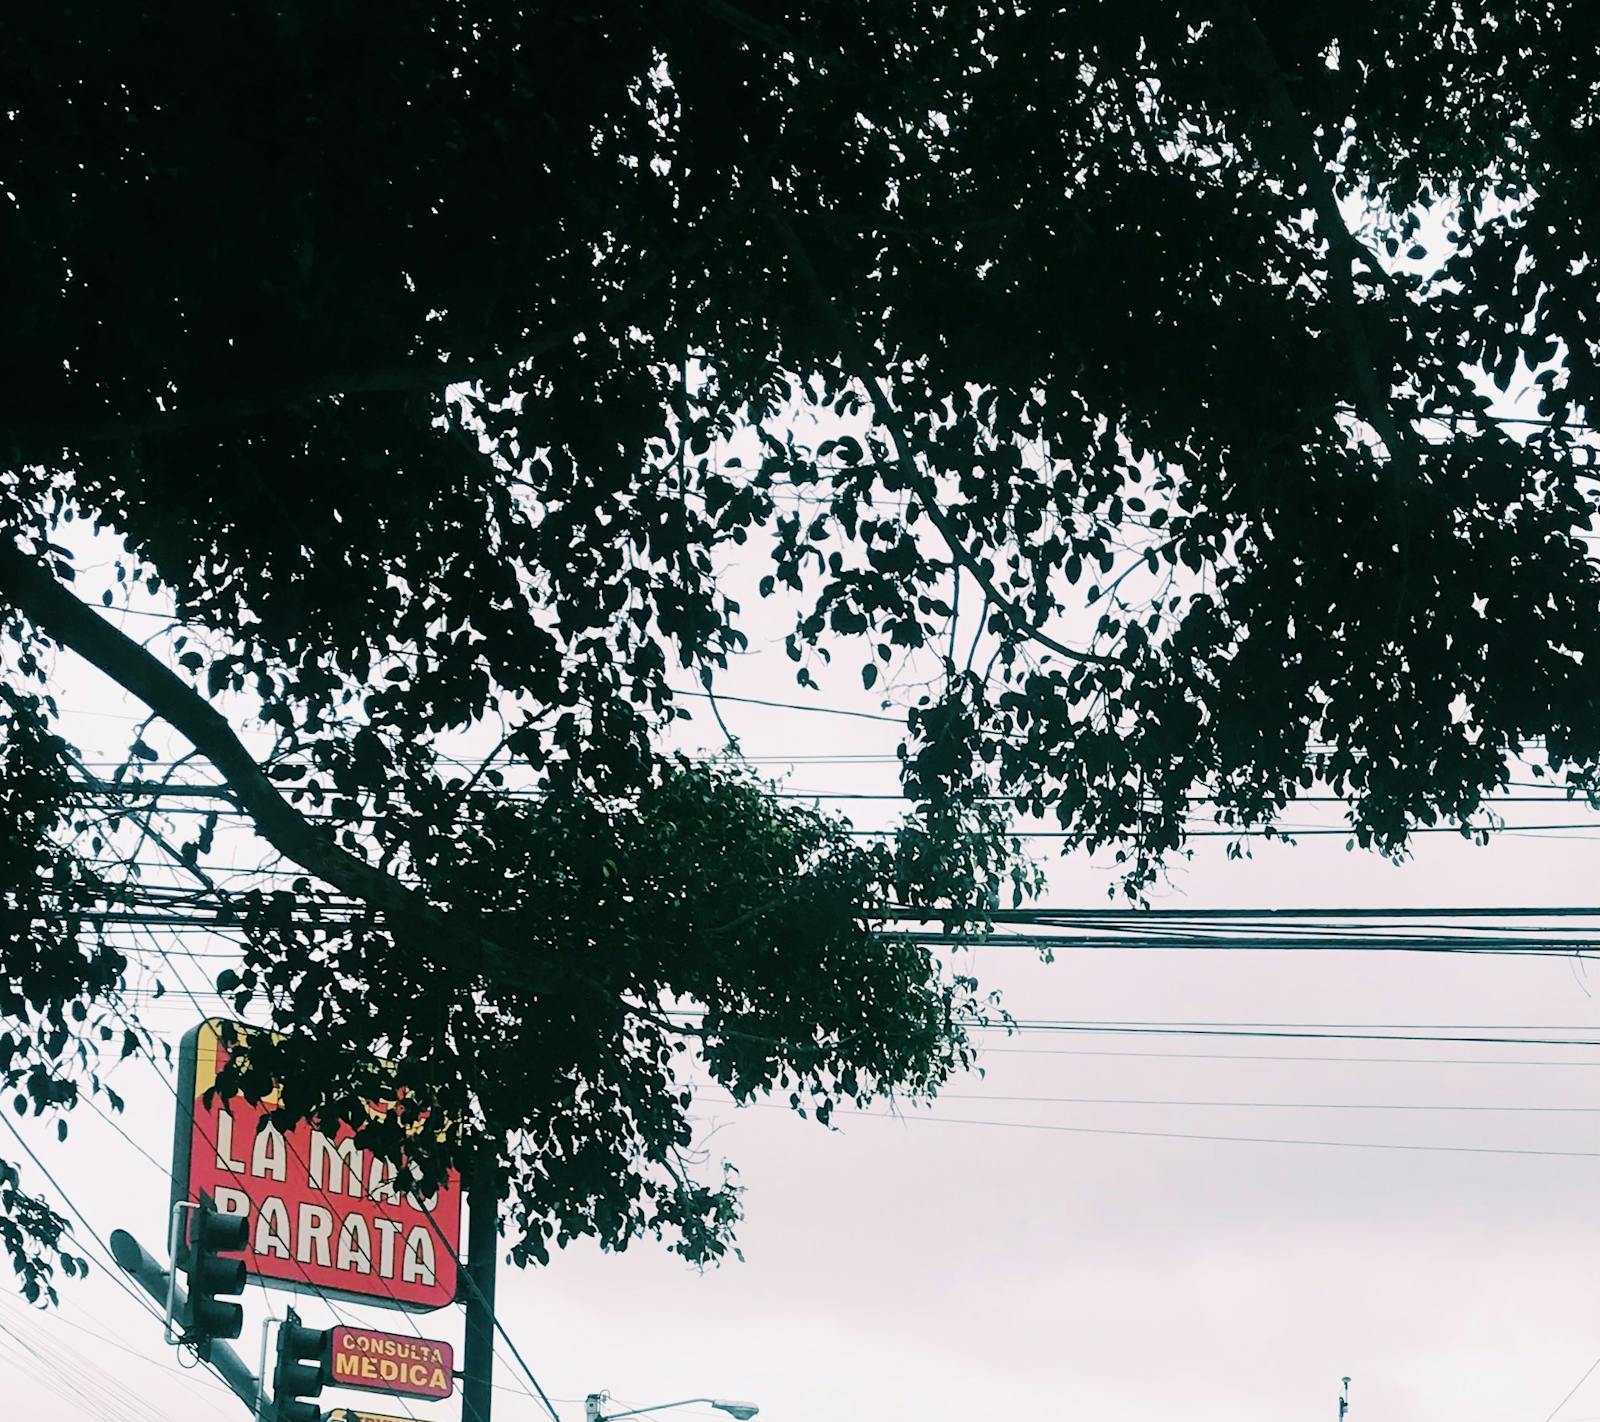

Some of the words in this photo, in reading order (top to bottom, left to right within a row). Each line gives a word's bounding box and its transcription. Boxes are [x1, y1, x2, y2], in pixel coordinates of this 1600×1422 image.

[215, 1110, 288, 1182] LA
[342, 1334, 444, 1364] CONSULTA
[336, 1352, 448, 1390] MEDICA
